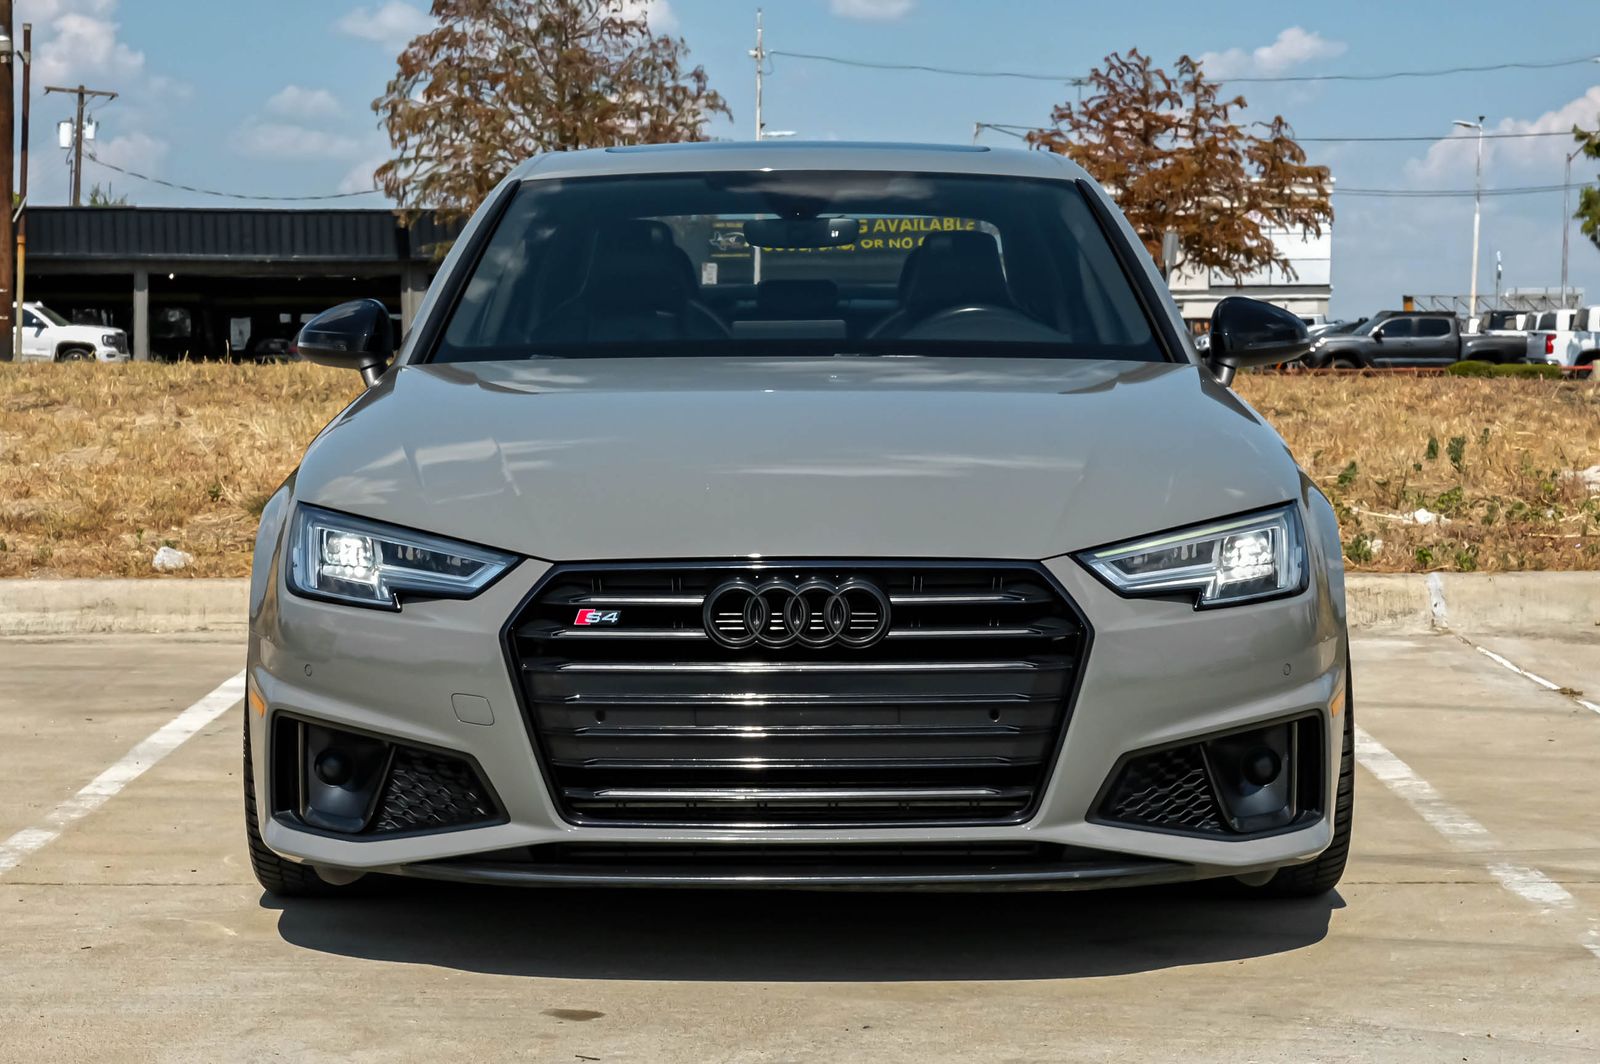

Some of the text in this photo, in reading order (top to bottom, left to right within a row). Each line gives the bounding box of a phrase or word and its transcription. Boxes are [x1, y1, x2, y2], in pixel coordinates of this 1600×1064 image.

[873, 217, 975, 233] AVAILABLE
[860, 239, 884, 249] OR
[888, 237, 913, 249] NO
[584, 611, 619, 624] S4
